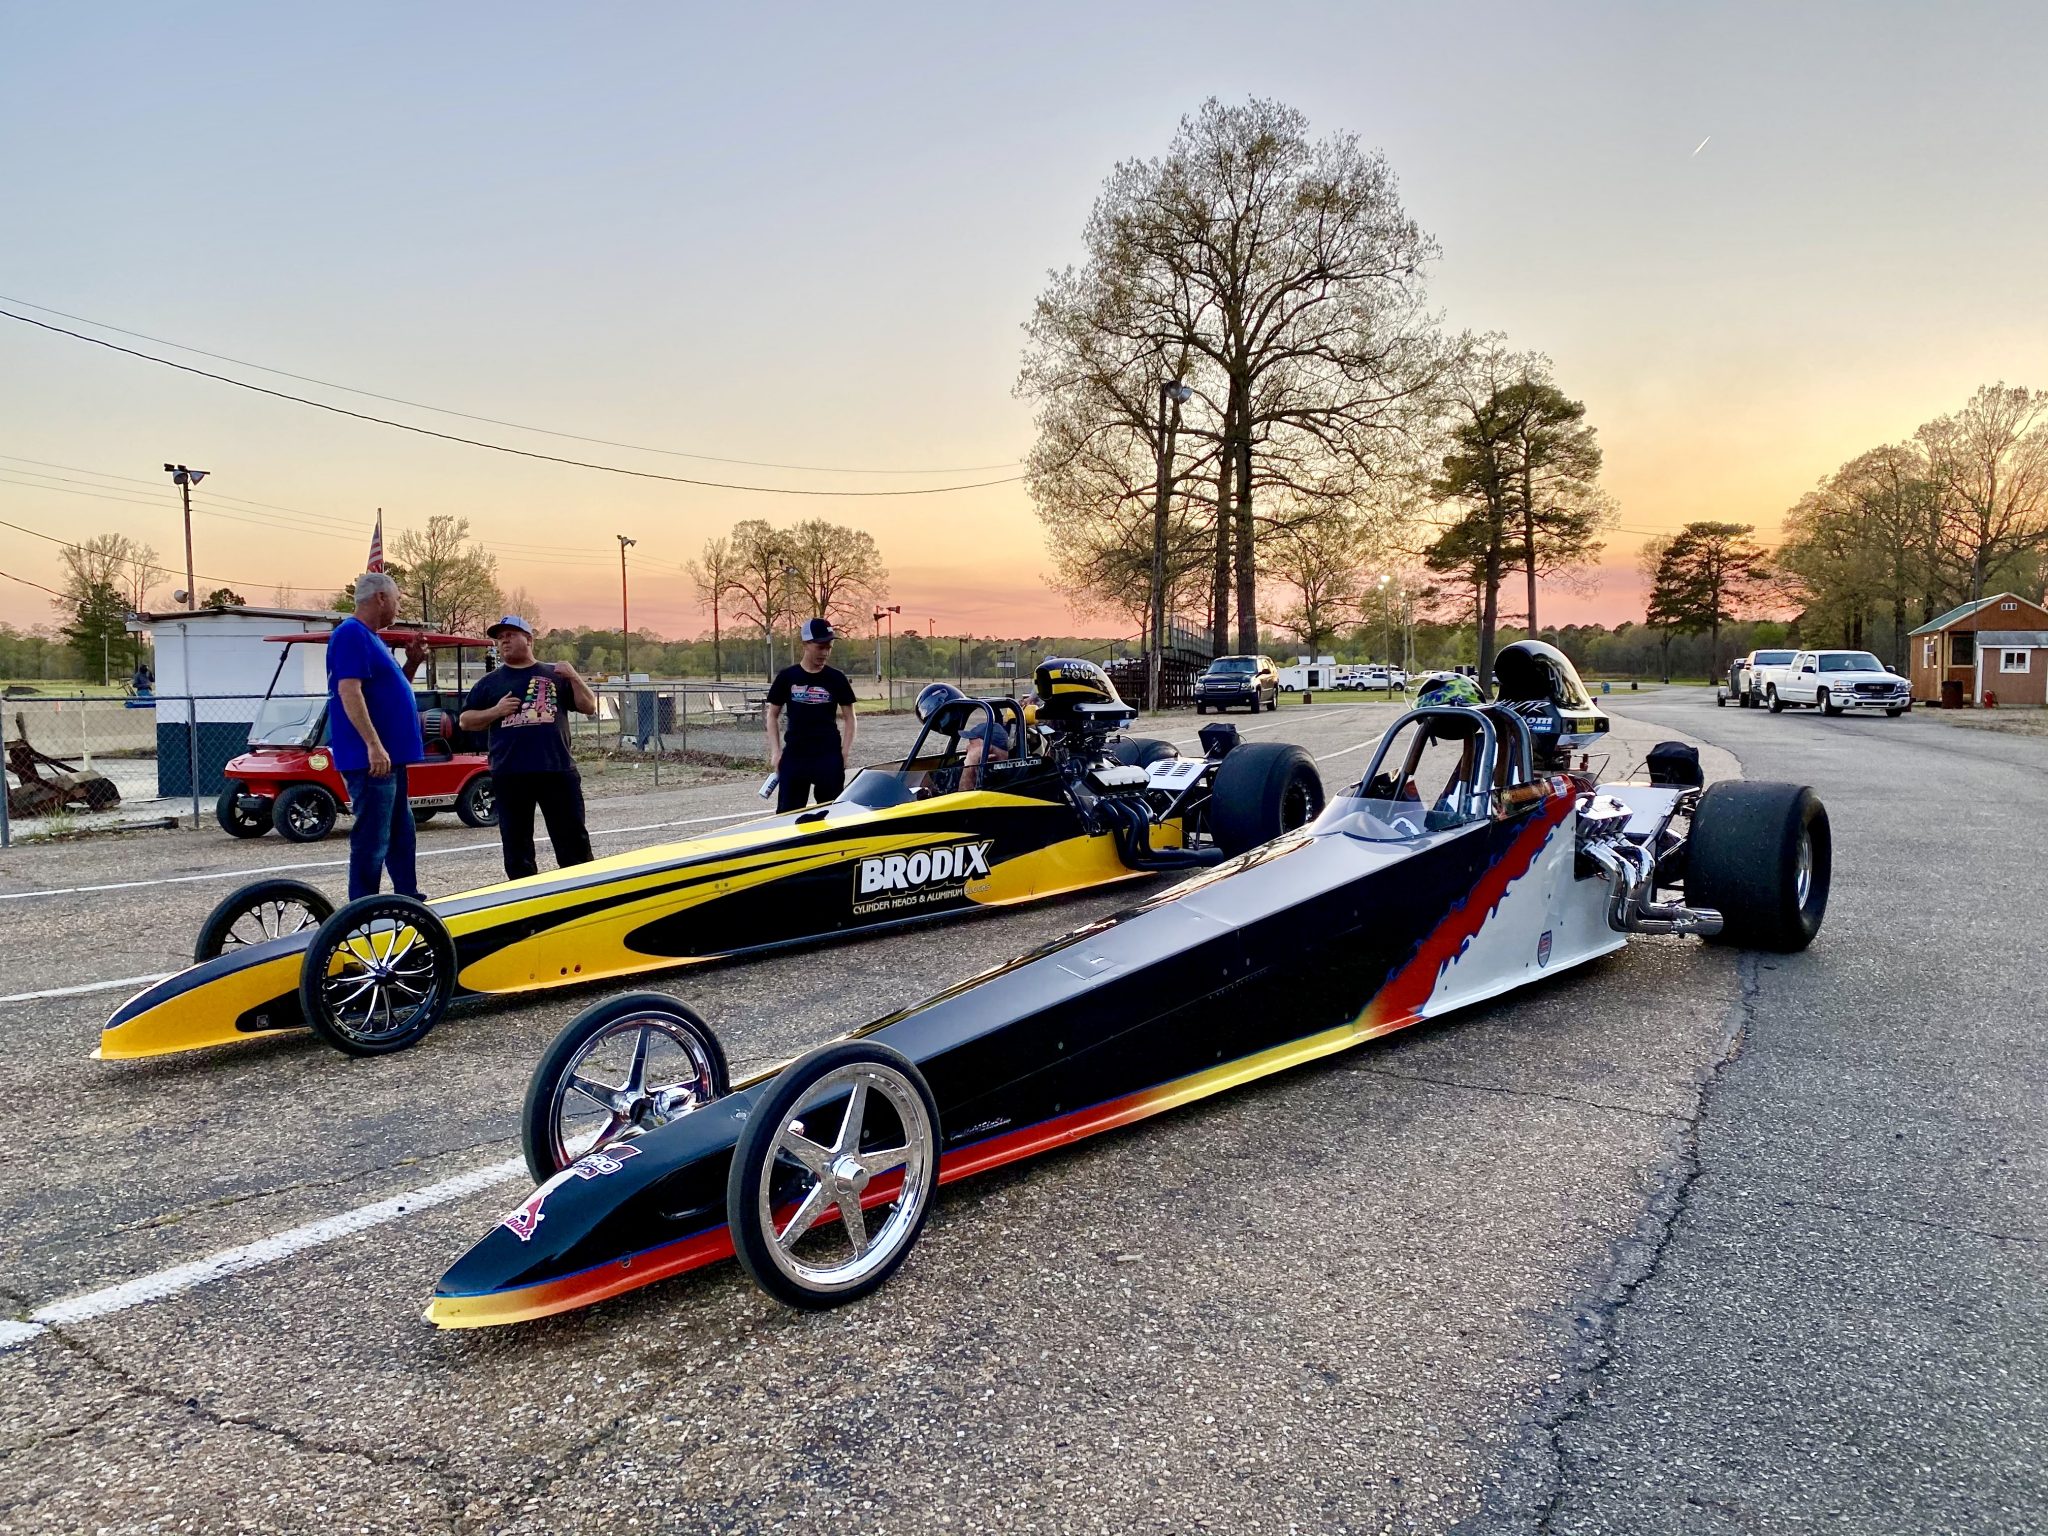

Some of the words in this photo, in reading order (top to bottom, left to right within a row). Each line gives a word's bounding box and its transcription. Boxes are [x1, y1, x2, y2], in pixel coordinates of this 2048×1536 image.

[860, 842, 990, 894] BRODIX
[853, 900, 890, 915] CYLINDER
[891, 895, 918, 909] HEADS
[919, 894, 926, 903] &
[926, 887, 963, 902] ALUMINUM
